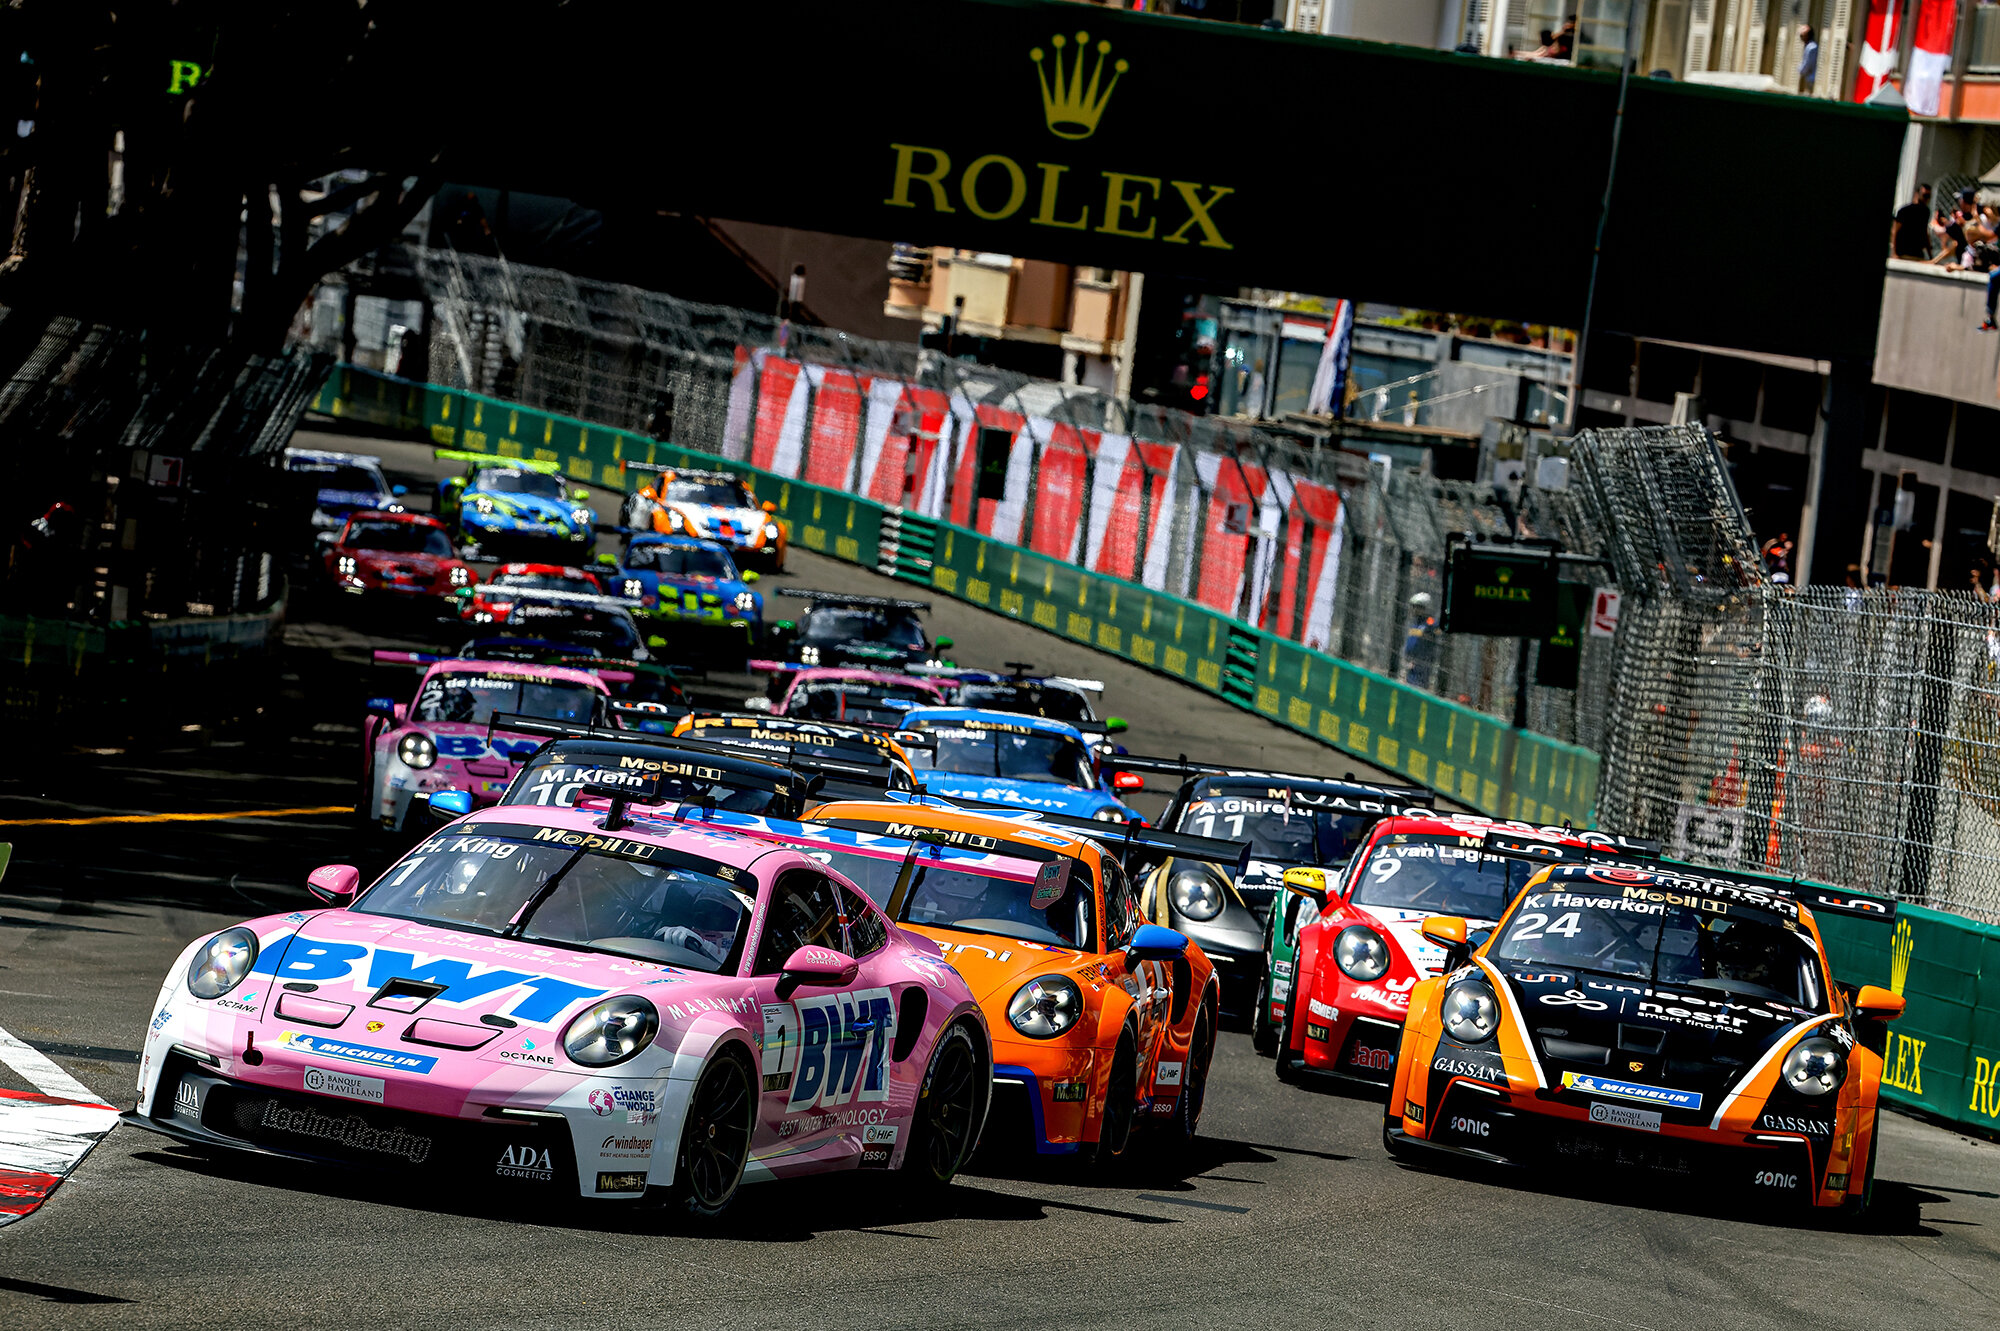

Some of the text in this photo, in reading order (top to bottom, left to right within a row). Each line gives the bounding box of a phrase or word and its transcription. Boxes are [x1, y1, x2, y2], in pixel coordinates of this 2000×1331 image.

[884, 143, 1235, 250] ROLEX
[620, 756, 692, 776] Mobil
[886, 823, 965, 845] Mobil
[1189, 815, 1246, 838] 11
[449, 836, 519, 859] King
[533, 828, 624, 852] Mobil
[1396, 846, 1434, 859] van
[391, 857, 427, 887] 1
[1370, 857, 1402, 883] 9
[1622, 887, 1697, 908] Mobil
[1511, 913, 1581, 941] 24
[805, 951, 841, 963] ADA
[250, 934, 611, 1023] BWT
[217, 999, 258, 1013] OCTANE
[667, 996, 758, 1020] MABANAFT
[1638, 1000, 1748, 1027] nestr
[1637, 1011, 1743, 1035] smart finance
[318, 1043, 422, 1067] MICHELIN
[500, 1051, 554, 1065] OCTANE
[777, 1025, 786, 1072] 1
[791, 997, 894, 1103] BWT
[1434, 1057, 1501, 1082] GASSAN
[328, 1075, 362, 1088] BANQUE
[328, 1083, 382, 1100] HAVILLAND
[1599, 1080, 1689, 1103] MICHELIN
[175, 1081, 199, 1108] ADA
[614, 1091, 655, 1102] CHANGE
[625, 1102, 656, 1112] WORLD
[1153, 1104, 1172, 1112] ESSO
[1611, 1109, 1641, 1119] BANQUE
[779, 1109, 888, 1136] BEST WATER TECHNOLOGY
[1609, 1115, 1660, 1130] HAVILLAND
[1763, 1114, 1830, 1136] GASSAN
[615, 1136, 653, 1152] windhager
[876, 1129, 894, 1140] HIF
[498, 1145, 553, 1169] ADA
[863, 1151, 887, 1161] ESSO
[496, 1168, 551, 1181] COSMETICS
